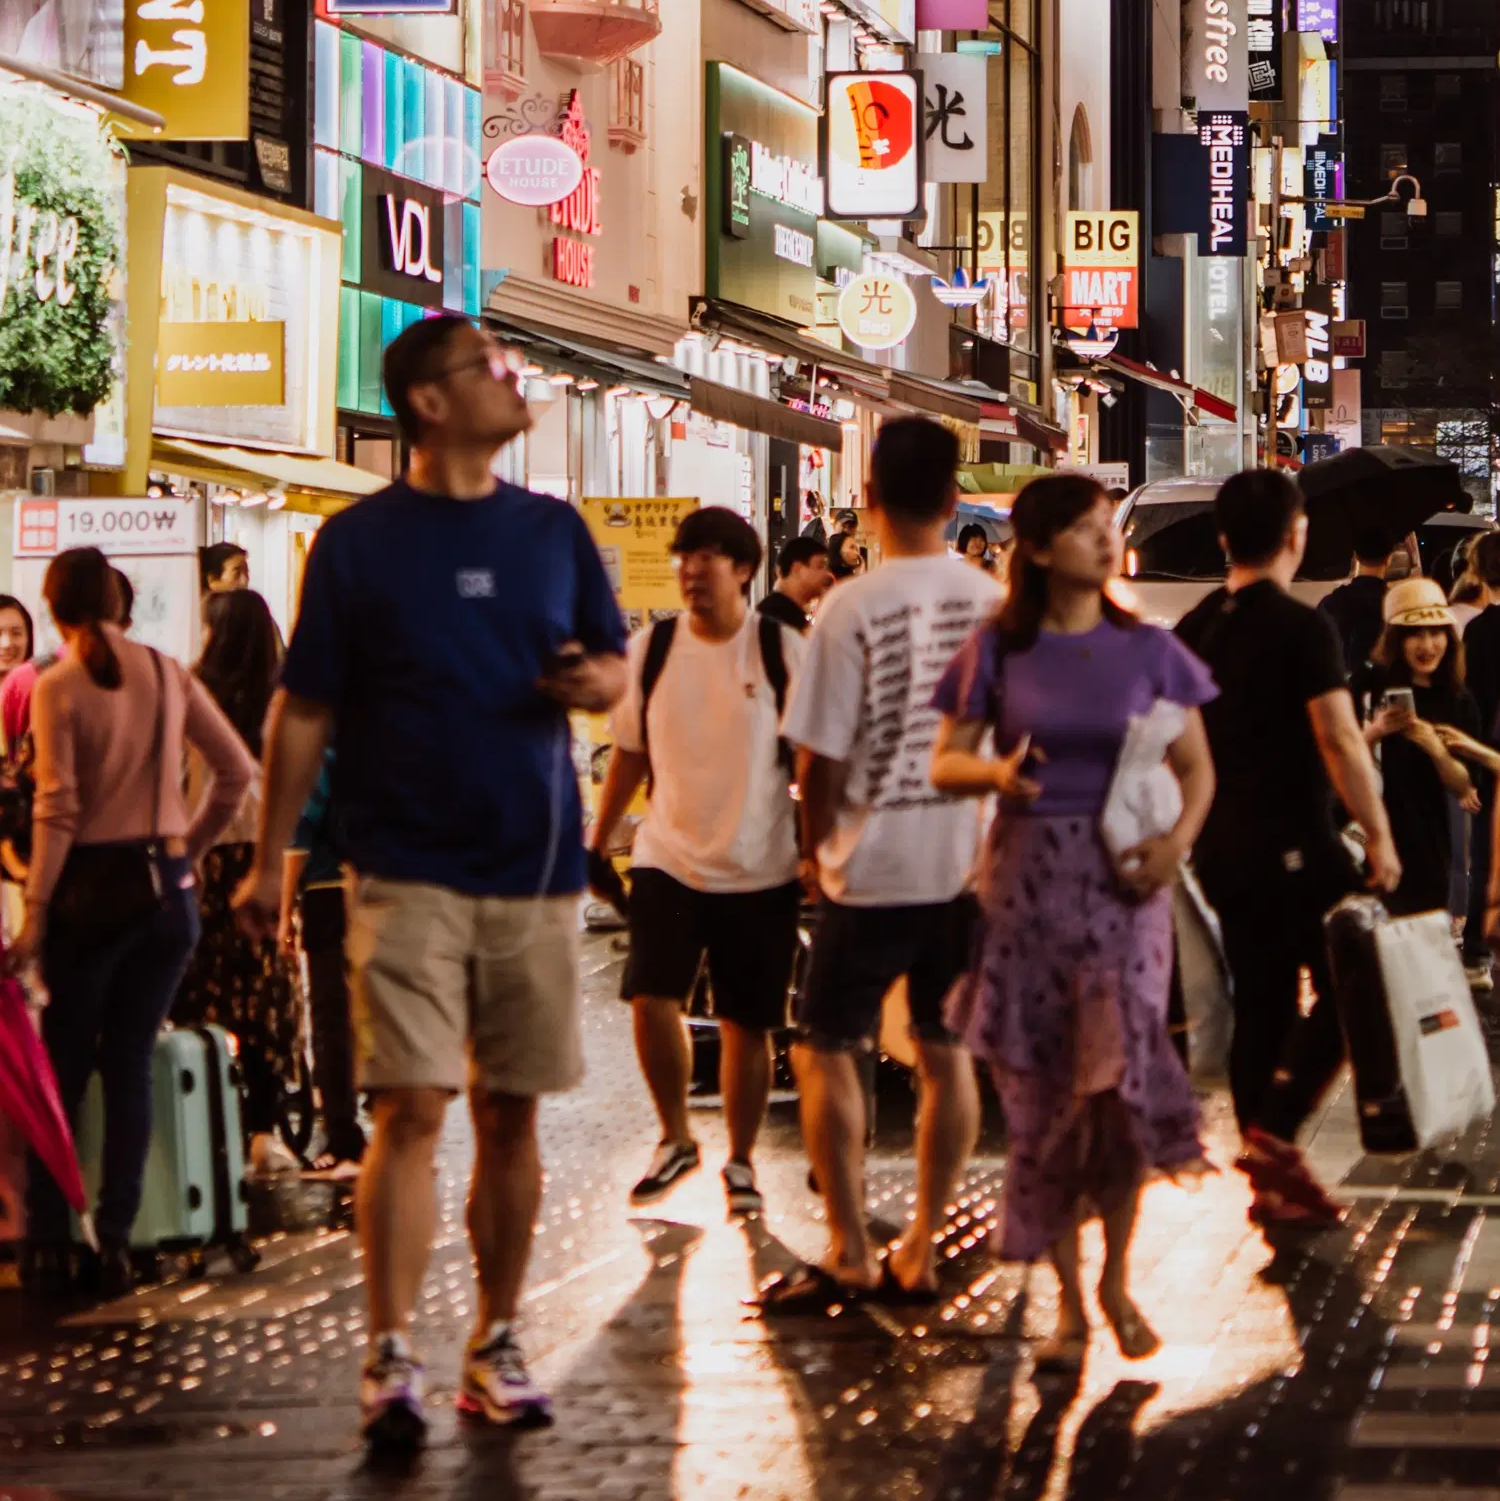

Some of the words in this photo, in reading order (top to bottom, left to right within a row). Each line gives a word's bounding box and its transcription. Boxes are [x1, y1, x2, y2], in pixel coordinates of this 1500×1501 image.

[924, 83, 975, 151] 光
[498, 155, 570, 179] ETUDE
[508, 177, 559, 190] HOUSE
[1210, 125, 1234, 252] MEDIHEAL
[386, 193, 442, 284] VDL
[1074, 219, 1131, 252] BIG
[553, 236, 596, 289] HOUSE
[858, 279, 893, 315] 光
[1070, 271, 1133, 307] MART
[1304, 309, 1330, 385] MLB
